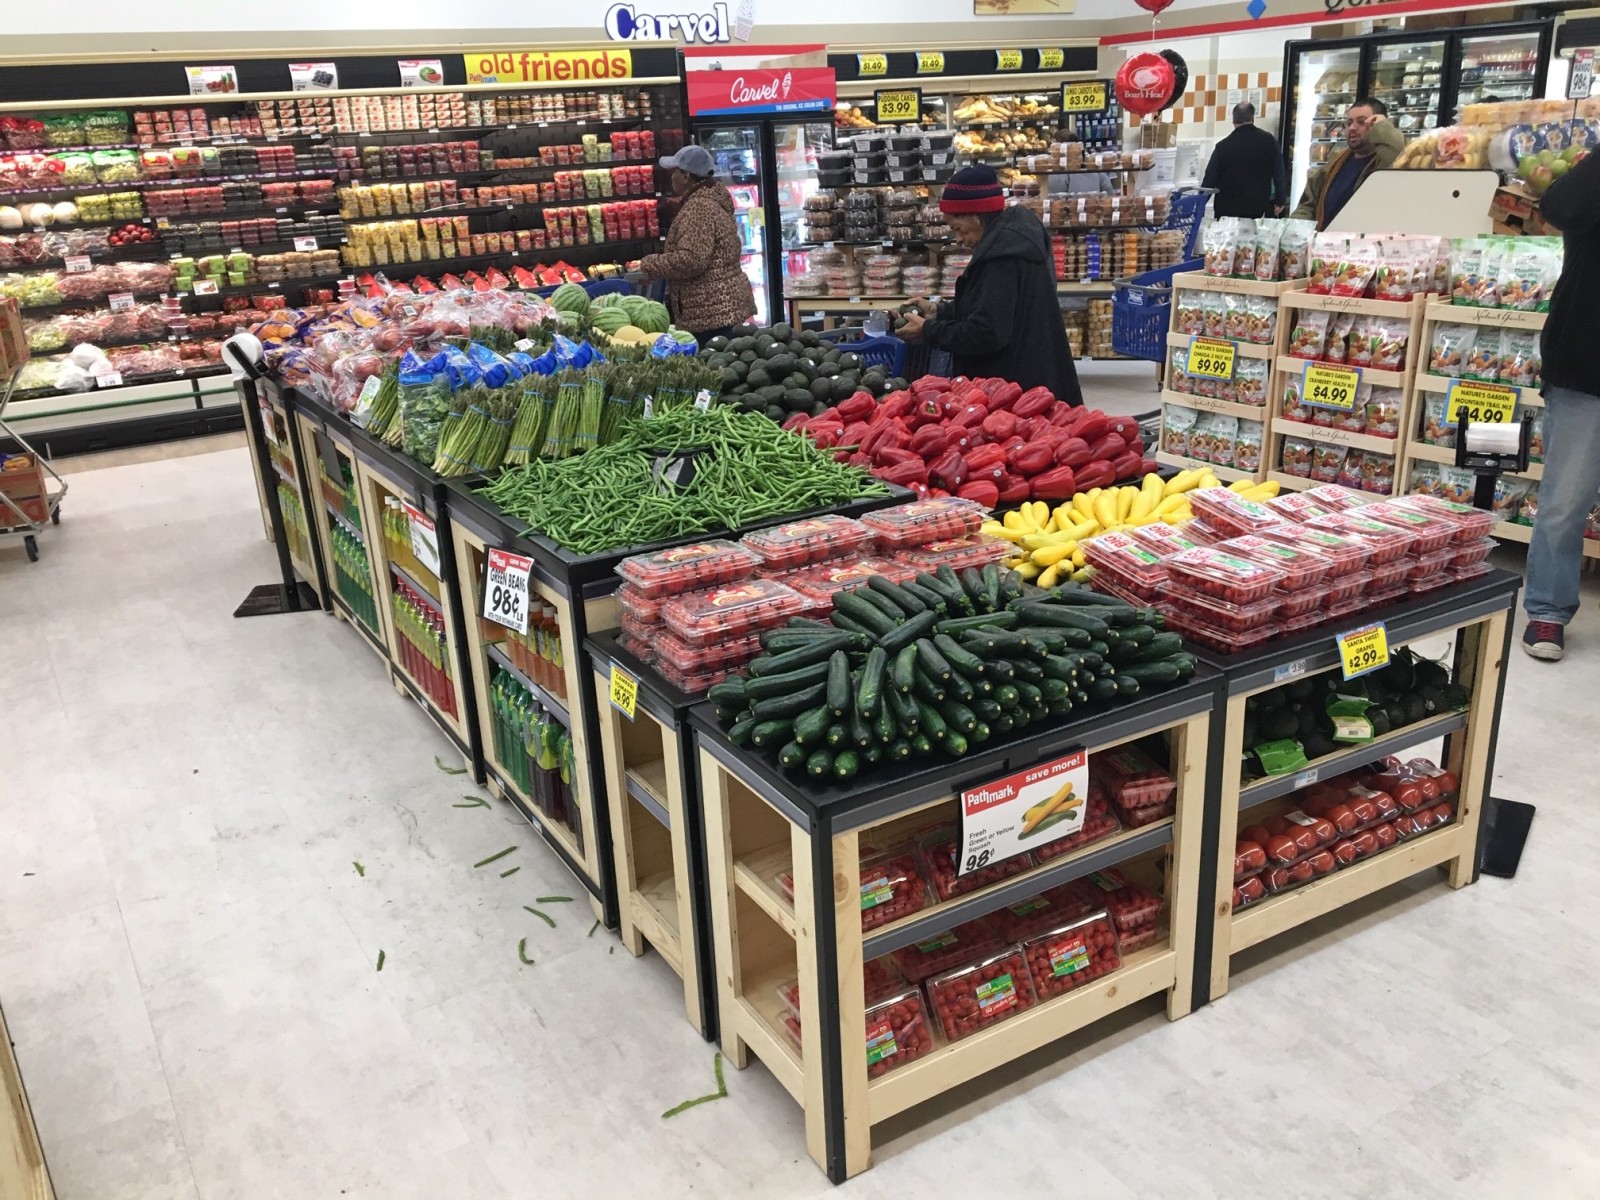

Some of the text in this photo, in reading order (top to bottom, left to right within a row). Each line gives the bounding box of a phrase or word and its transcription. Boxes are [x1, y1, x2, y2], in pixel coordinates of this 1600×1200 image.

[605, 3, 731, 43] Carvel
[479, 50, 628, 82] old friends
[863, 61, 882, 70] $1.49
[921, 59, 940, 68] $1.49
[730, 77, 780, 104] Carvel
[878, 93, 916, 103] PUDDING CAKES
[1124, 90, 1164, 98] Boar's Head
[881, 101, 911, 114] $3.99
[1069, 95, 1095, 106] $3.99
[1197, 358, 1227, 374] $9.99
[1309, 377, 1332, 386] CRANBERRY
[1316, 370, 1351, 381] NATURE'S GARDEN
[1313, 385, 1348, 403] $4.99
[1460, 389, 1510, 401] NATURE'S GARDEN
[1454, 397, 1485, 407] MOUNTAIN
[1486, 401, 1501, 409] TRAIL
[1456, 406, 1504, 423] 4.99
[519, 561, 530, 569] more!
[490, 567, 526, 593] GREEN BEANS
[492, 585, 524, 622] 98¢ LB
[1347, 638, 1364, 648] SANTA
[1364, 632, 1380, 642] SWEET
[1355, 643, 1375, 654] GRAPES
[1349, 649, 1377, 669] $2.99
[614, 688, 630, 708] $6.99
[1025, 755, 1080, 783] save more!
[967, 784, 1014, 808] Pathmark
[968, 835, 988, 847] Green
[996, 825, 1016, 836] Yellow
[969, 828, 987, 839] Fresh
[968, 840, 992, 854] Squash
[965, 848, 995, 871] 98¢
